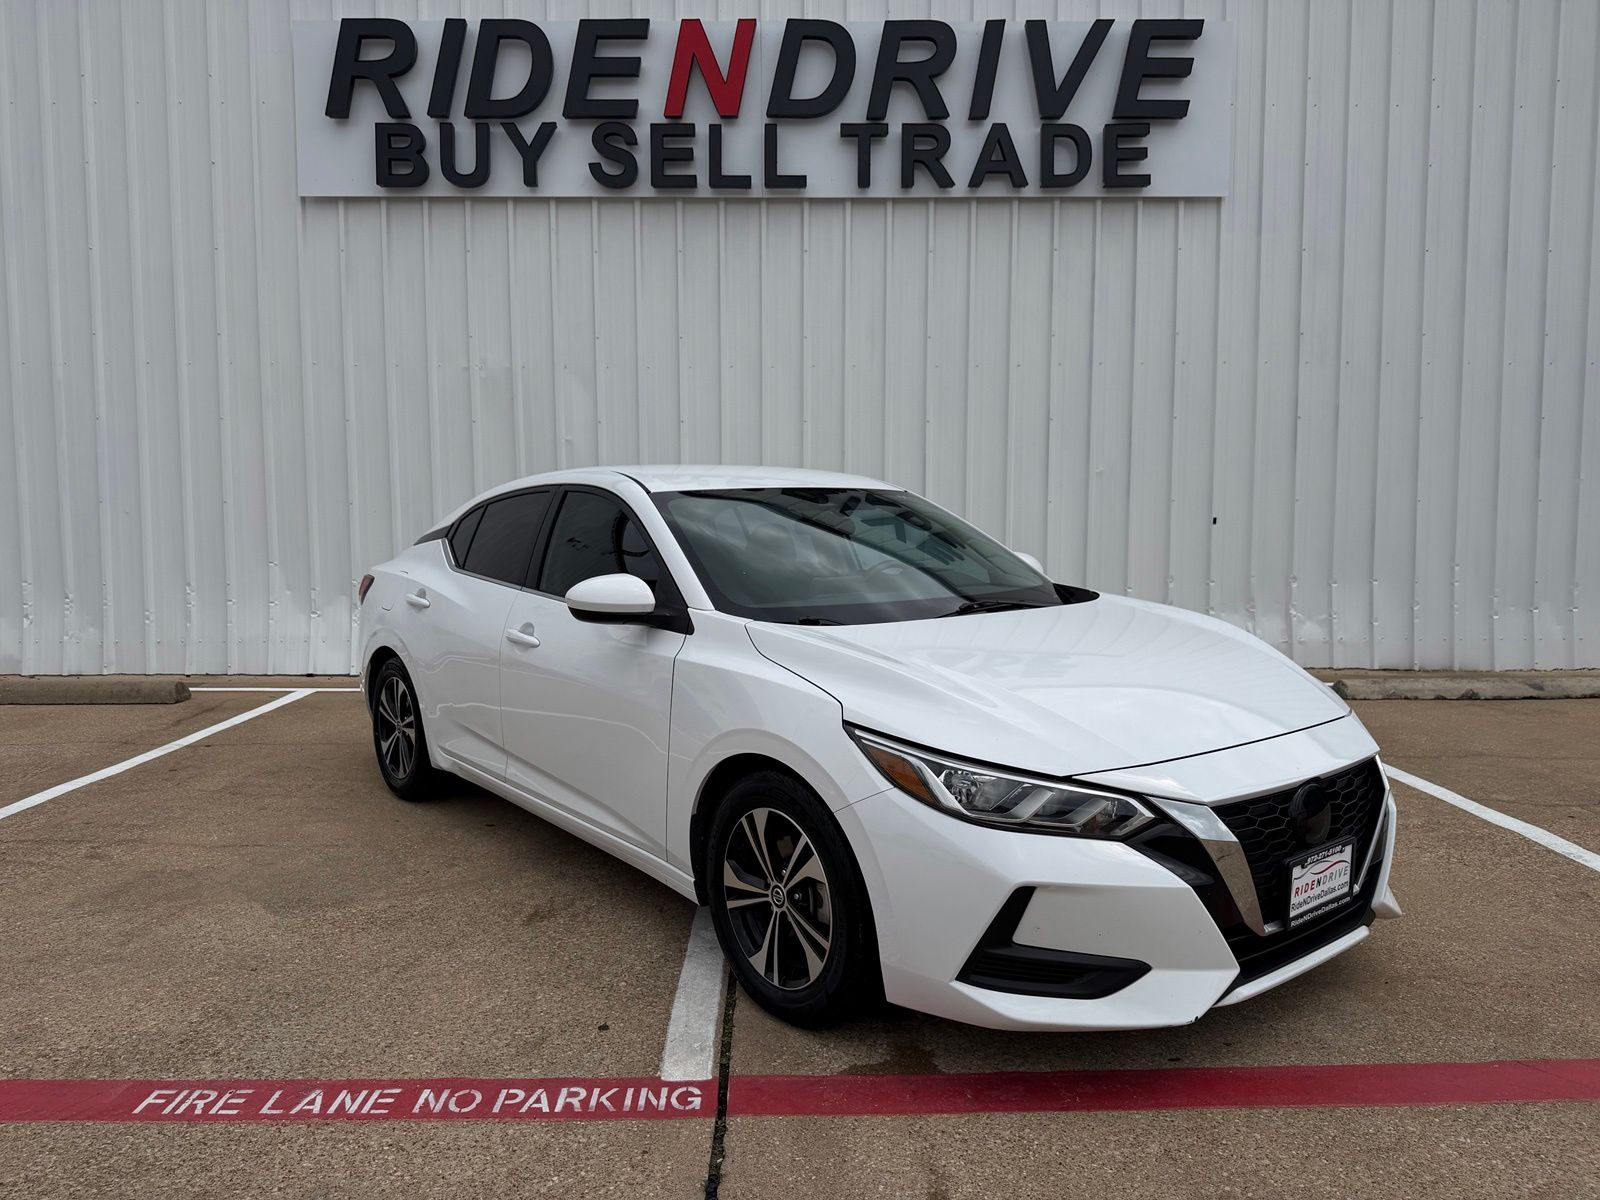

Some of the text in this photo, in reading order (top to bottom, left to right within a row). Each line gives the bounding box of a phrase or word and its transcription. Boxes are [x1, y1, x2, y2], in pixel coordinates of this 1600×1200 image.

[375, 122, 1151, 189] BUY SELL TRADE
[1290, 896, 1351, 928] RideNDriveDallas.com
[1291, 881, 1349, 912] RideNDriveDallas.com
[132, 1086, 703, 1115] FIRE LANE NO PARKING
